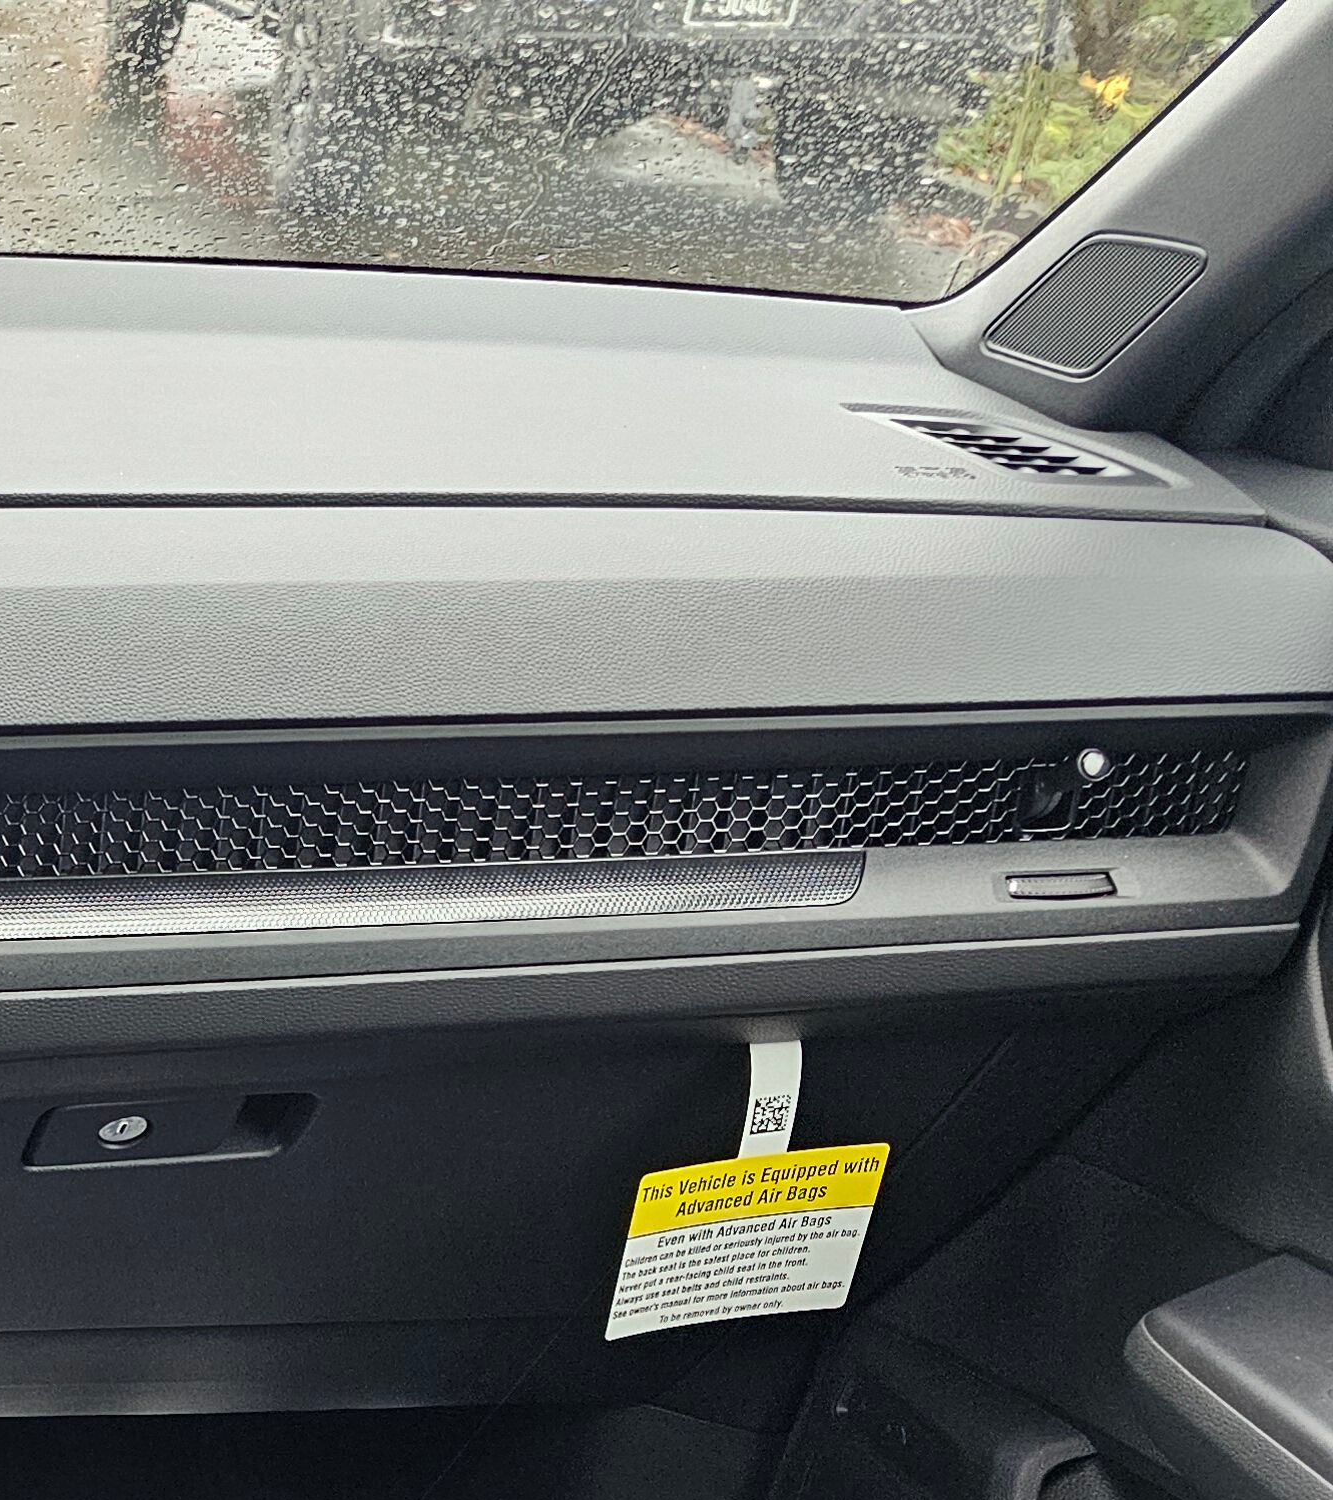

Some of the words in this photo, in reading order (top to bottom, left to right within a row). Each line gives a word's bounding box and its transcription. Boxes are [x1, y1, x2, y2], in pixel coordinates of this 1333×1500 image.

[643, 1184, 673, 1202] This
[679, 1173, 736, 1195] Vehicle
[742, 1170, 755, 1186] is
[761, 1160, 839, 1184] Equipped
[844, 1157, 879, 1174] with
[676, 1191, 754, 1217] Advanced
[757, 1188, 782, 1205] Air
[786, 1186, 827, 1201] Bags
[625, 1255, 658, 1268] Children
[659, 1252, 673, 1260] can
[676, 1248, 685, 1257] be
[687, 1244, 711, 1255] killed
[713, 1243, 722, 1251] or
[724, 1238, 763, 1250] seriously
[764, 1233, 794, 1245] injured
[797, 1232, 808, 1242] by
[810, 1231, 824, 1240] the
[826, 1229, 839, 1238] air
[840, 1229, 860, 1238] bag.
[658, 1235, 685, 1248] Even
[689, 1228, 713, 1242] with
[716, 1220, 776, 1239] Advanced
[779, 1218, 798, 1230] Air
[801, 1216, 832, 1228] Bags
[619, 1283, 642, 1294] Never
[643, 1279, 658, 1290] put
[666, 1269, 712, 1284] rear-facing
[713, 1265, 735, 1277] child
[736, 1263, 756, 1273] seat
[757, 1262, 766, 1270] in
[768, 1260, 782, 1269] the
[784, 1258, 808, 1267] front.
[622, 1271, 636, 1281] The
[638, 1267, 657, 1277] back
[659, 1262, 677, 1273] seat
[678, 1260, 686, 1269] is
[688, 1258, 702, 1268] the
[703, 1253, 730, 1265] safest
[732, 1251, 755, 1262] place
[757, 1249, 770, 1258] for
[772, 1245, 811, 1256] children.
[612, 1311, 627, 1320] See
[629, 1303, 659, 1317] owner's
[661, 1297, 691, 1308] manual
[693, 1295, 705, 1304] for
[706, 1292, 728, 1301] more
[730, 1285, 779, 1299] information
[781, 1282, 805, 1293] about
[807, 1281, 819, 1290] air
[821, 1280, 845, 1290] bags.
[615, 1294, 643, 1307] Always
[645, 1292, 659, 1300] use
[661, 1286, 679, 1296] seat
[681, 1283, 702, 1292] belts
[704, 1280, 720, 1290] and
[722, 1277, 744, 1288] child
[745, 1272, 789, 1285] restraints.
[660, 1315, 669, 1324] To
[672, 1312, 681, 1321] be
[683, 1306, 720, 1320] removed
[722, 1304, 732, 1314] by
[734, 1303, 761, 1312] owner
[763, 1300, 783, 1309] only.
